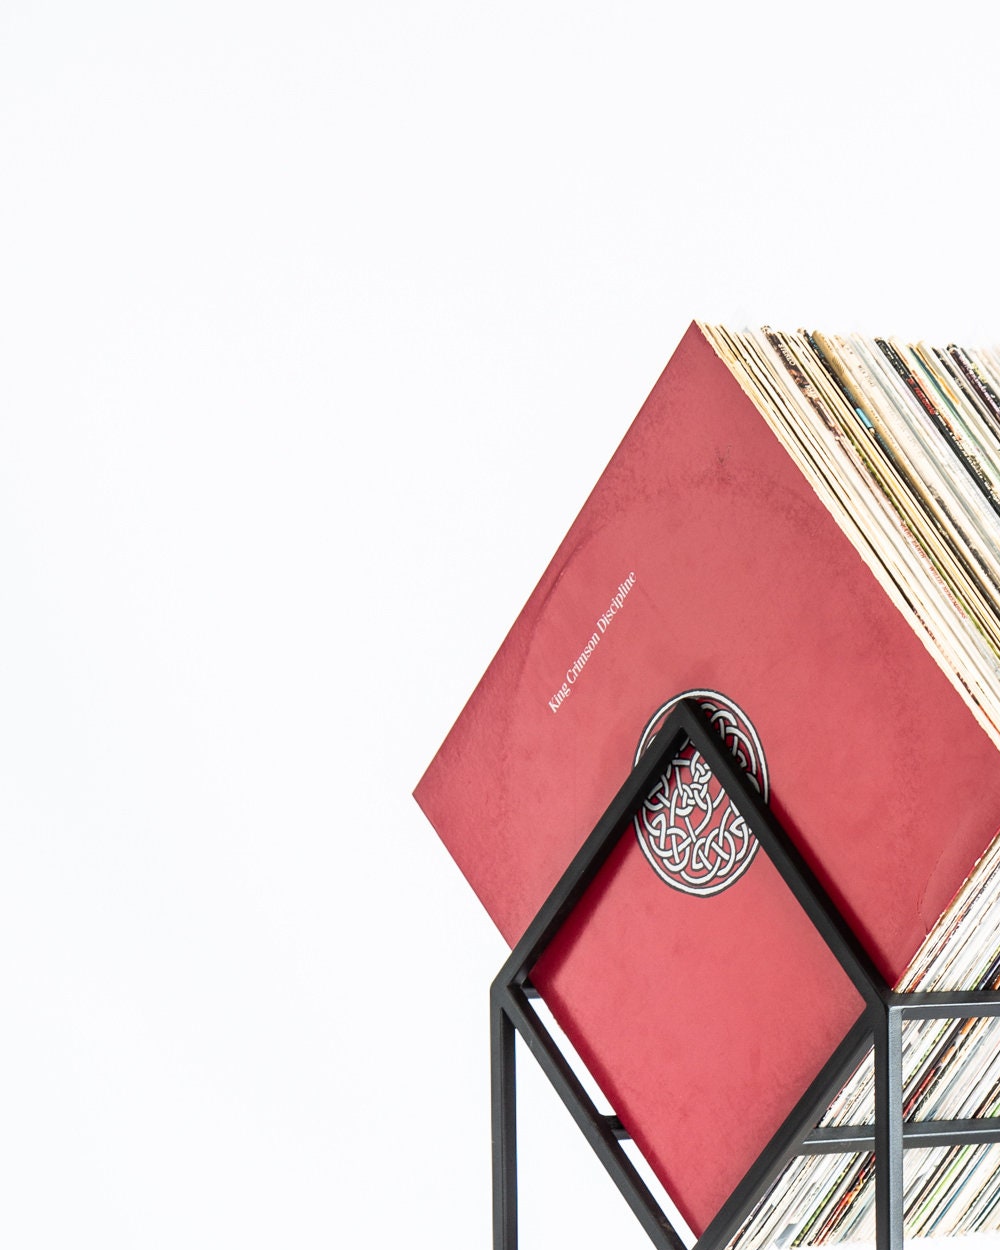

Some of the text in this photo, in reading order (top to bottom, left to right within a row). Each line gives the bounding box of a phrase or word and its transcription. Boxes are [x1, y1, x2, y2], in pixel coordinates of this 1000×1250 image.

[548, 572, 635, 713] King Crimson Discipline
